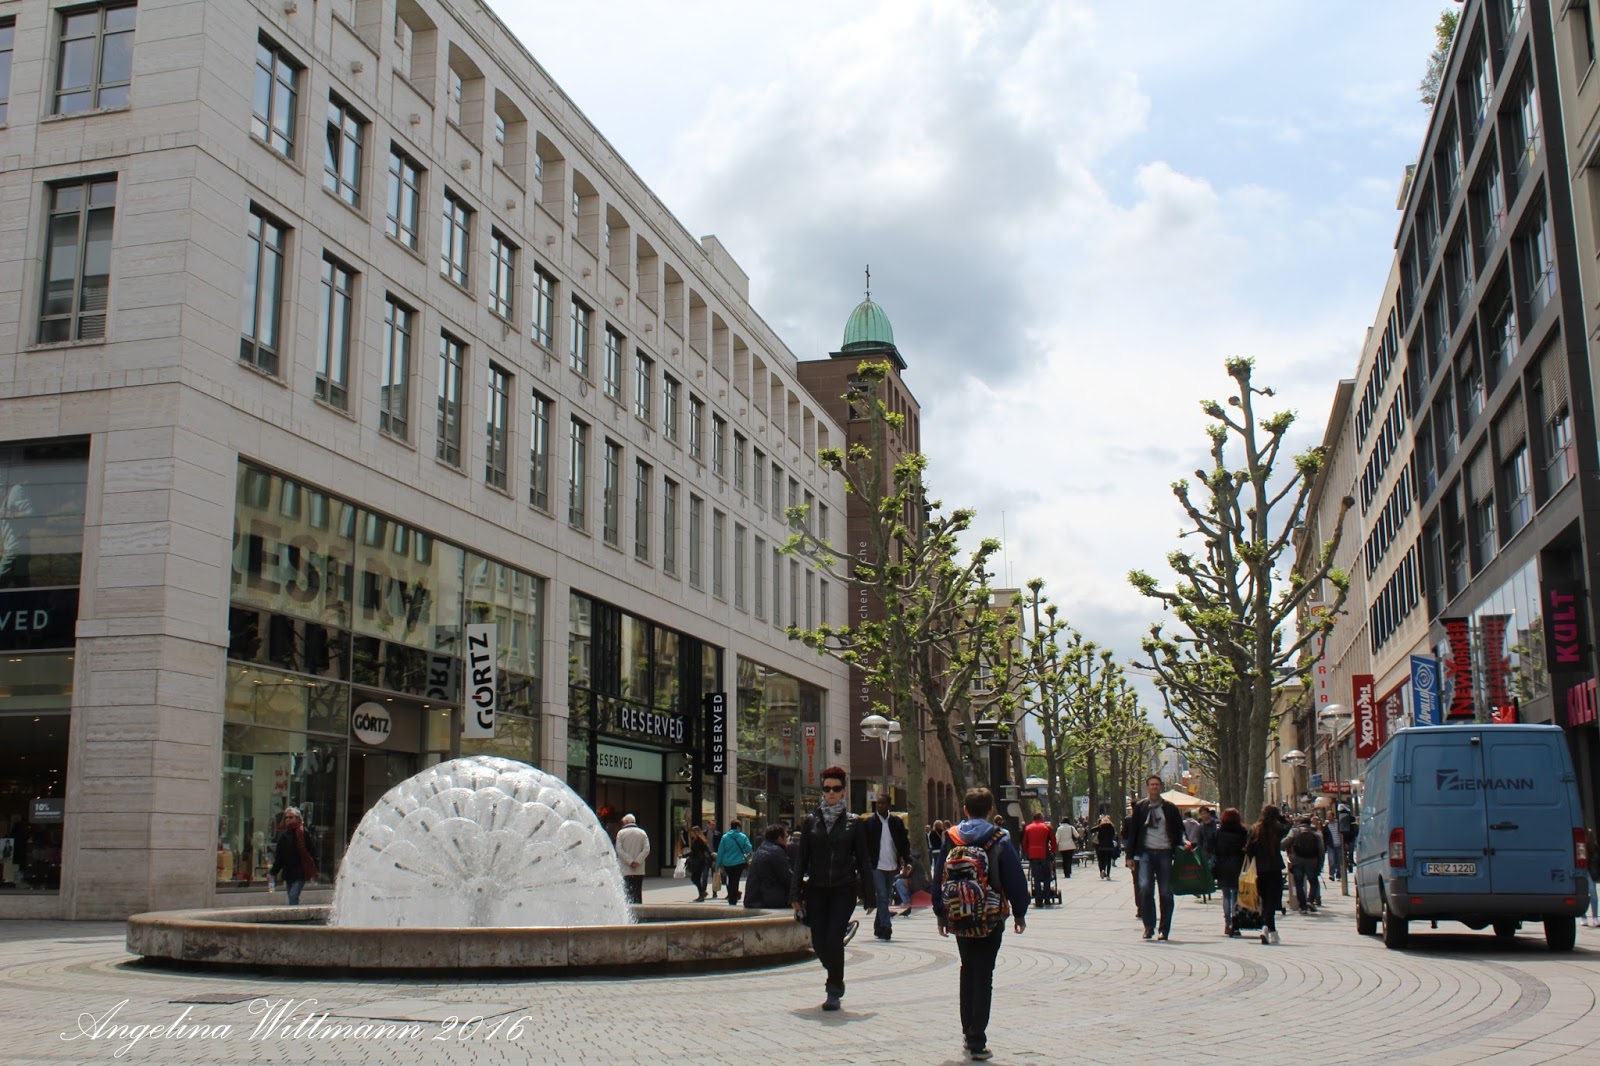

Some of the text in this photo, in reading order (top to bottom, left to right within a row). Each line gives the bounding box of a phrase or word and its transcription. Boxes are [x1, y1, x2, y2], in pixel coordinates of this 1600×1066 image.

[1551, 589, 1580, 662] KULT
[860, 681, 869, 702] der
[1567, 678, 1597, 727] KULT
[621, 707, 684, 739] RESERVED
[714, 695, 723, 773] RESERVED
[861, 711, 869, 742] Hs
[597, 753, 633, 770] ESERVED
[1428, 864, 1439, 873] FR
[1453, 864, 1475, 873] 1220
